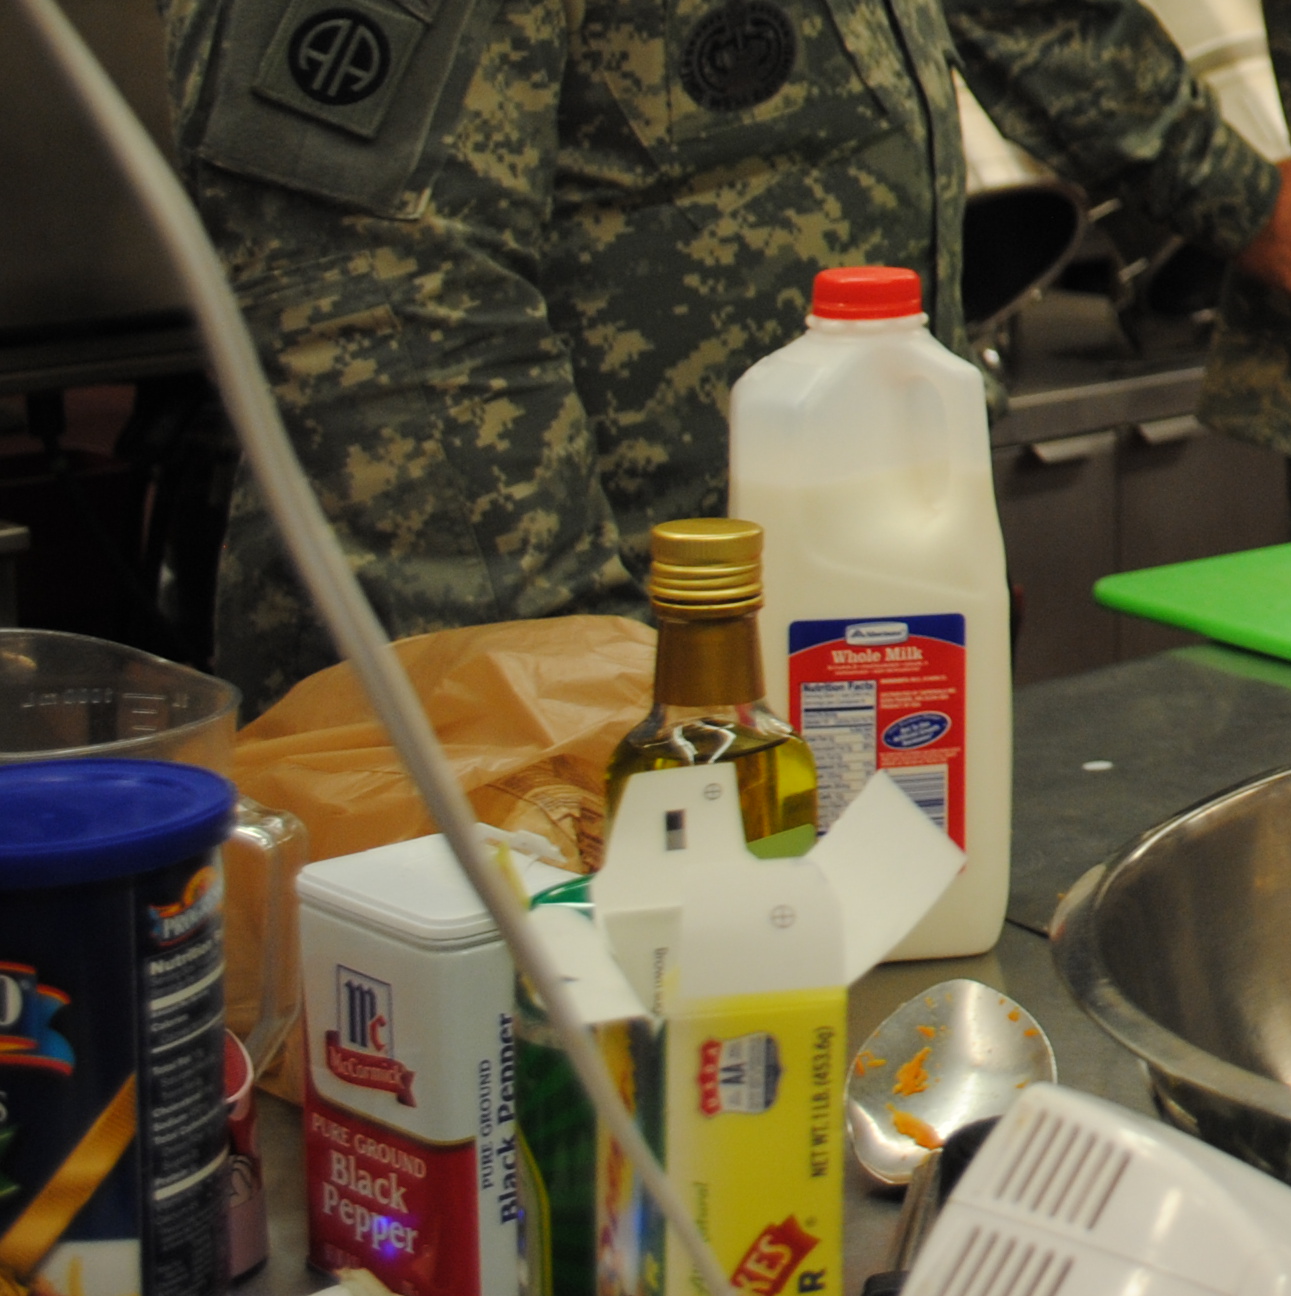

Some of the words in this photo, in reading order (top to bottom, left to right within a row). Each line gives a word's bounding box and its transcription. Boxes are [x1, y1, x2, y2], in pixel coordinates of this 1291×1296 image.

[831, 649, 881, 664] Whole
[884, 646, 923, 662] Milk
[479, 1059, 493, 1138] GROUND
[310, 1111, 351, 1148] PURE
[352, 1133, 428, 1179] GROUND
[481, 1140, 495, 1190] PURE
[811, 1153, 829, 1178] NET
[329, 1149, 409, 1214] Black
[497, 1133, 519, 1224] Black
[322, 1181, 419, 1254] Pepper
